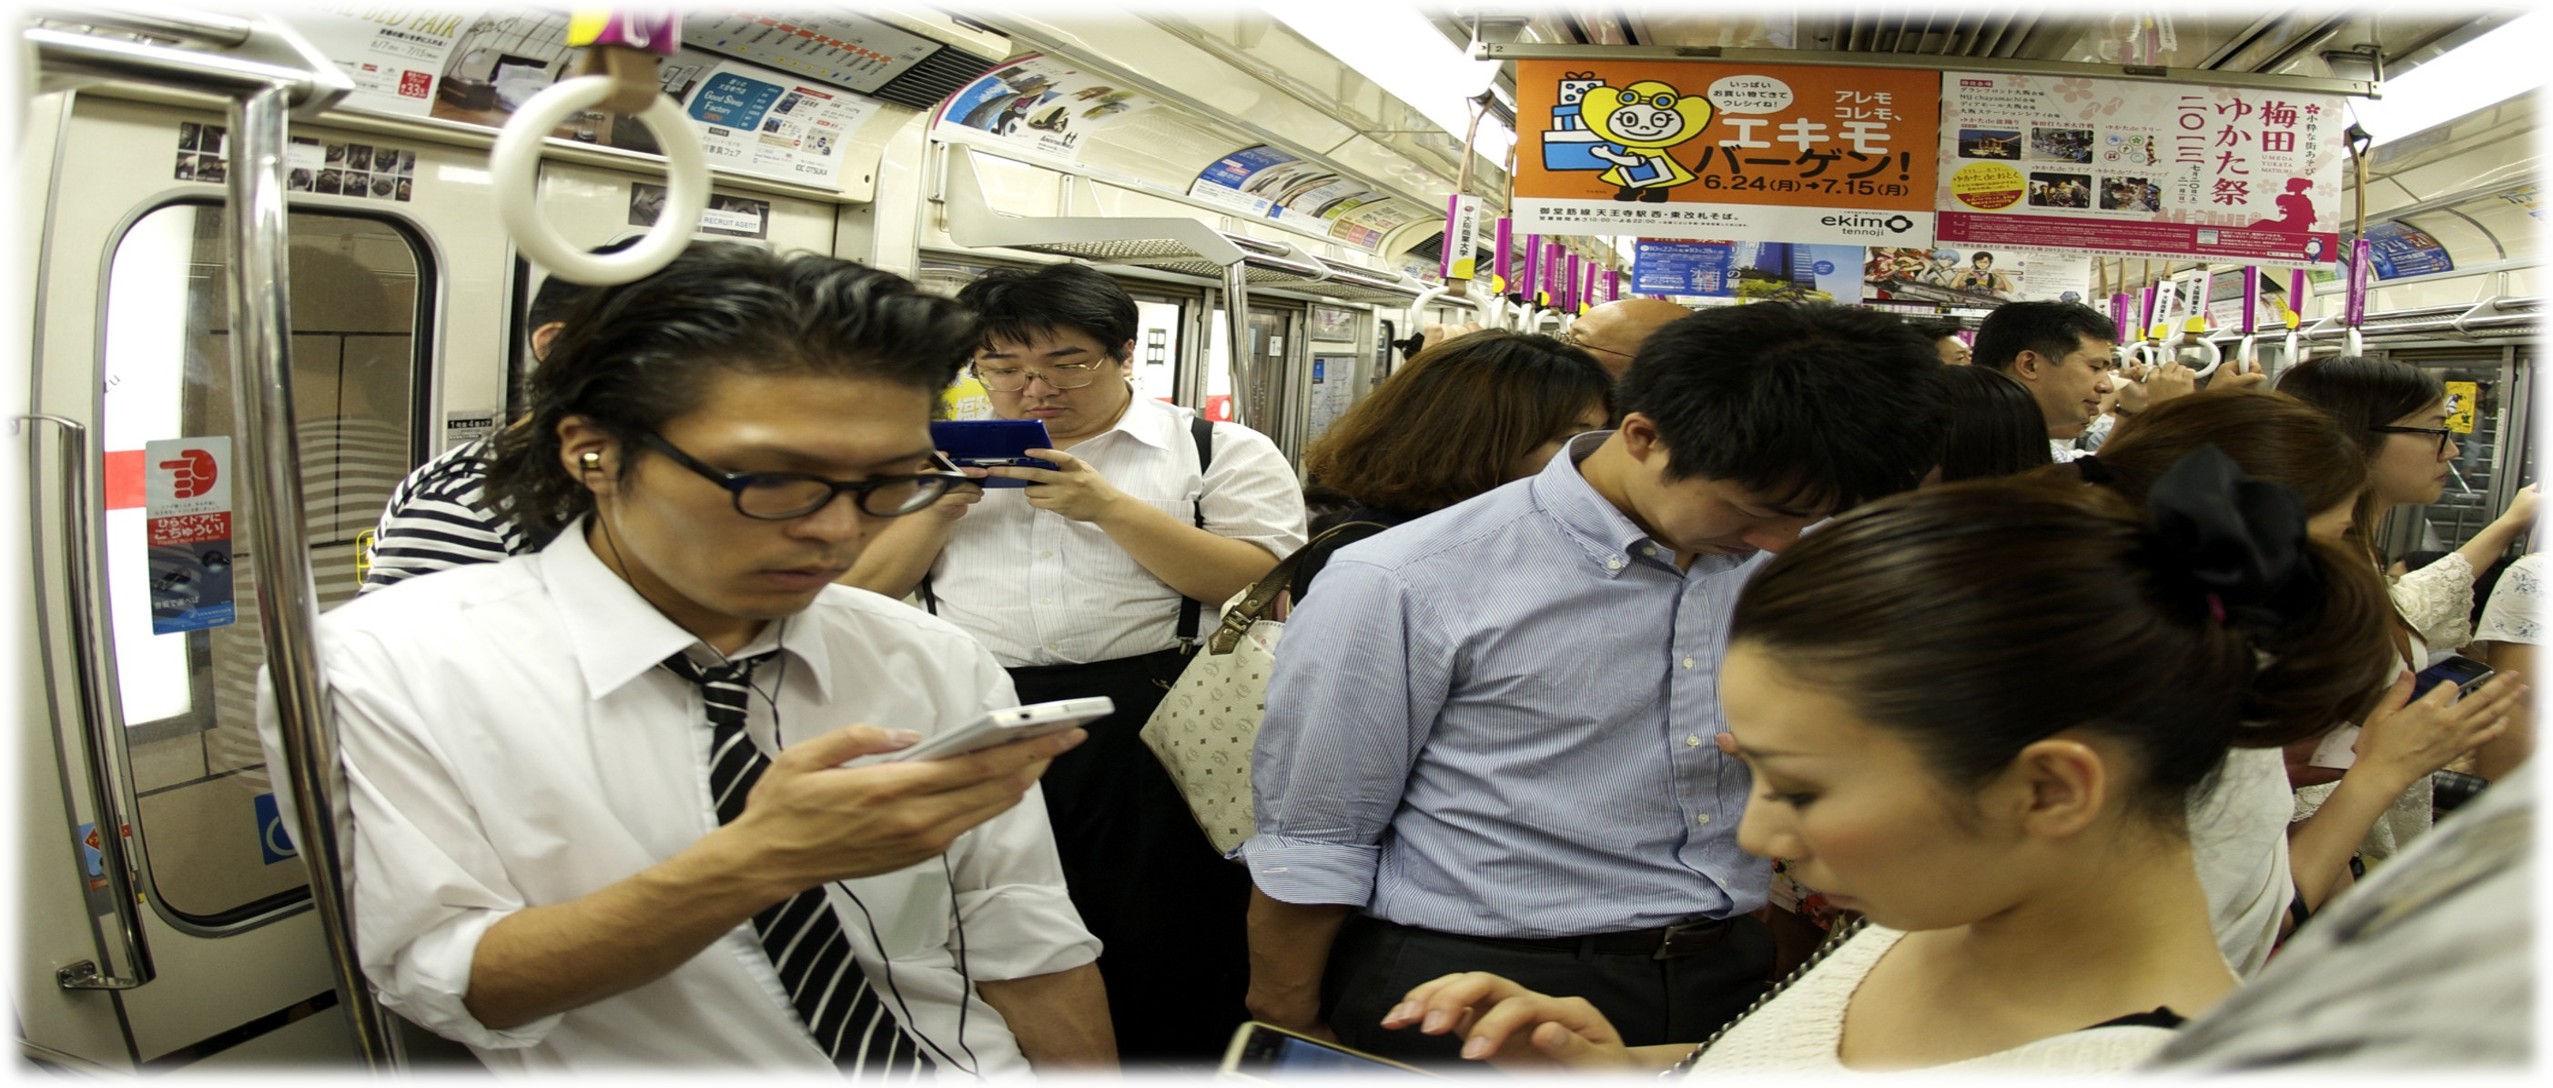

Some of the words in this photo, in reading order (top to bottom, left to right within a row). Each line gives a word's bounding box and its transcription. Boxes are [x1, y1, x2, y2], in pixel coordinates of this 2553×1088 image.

[408, 10, 463, 38] FAIR
[1713, 90, 1788, 99] お買い物できて
[1834, 90, 1892, 105] アレモ
[1723, 100, 1778, 108] ウレシイね!
[1834, 106, 1902, 121] コレモ、
[1718, 117, 1892, 154] エキモ
[2258, 101, 2300, 152] 梅田
[2210, 98, 2253, 206] ゆかた祭
[2304, 115, 2318, 176] 小粋な街あそび
[1693, 145, 1911, 181] バーゲン!
[1704, 175, 1801, 192] 6.24(月)
[1821, 179, 1909, 196] 7.15(月)
[1539, 207, 1591, 216] 御堂筋線
[703, 216, 734, 227] RECRUIT
[1821, 214, 1914, 233] ekimo
[1842, 228, 1884, 236] tennoji
[158, 514, 221, 528] ひらくドアに
[154, 522, 225, 540] ごちゅうい!
